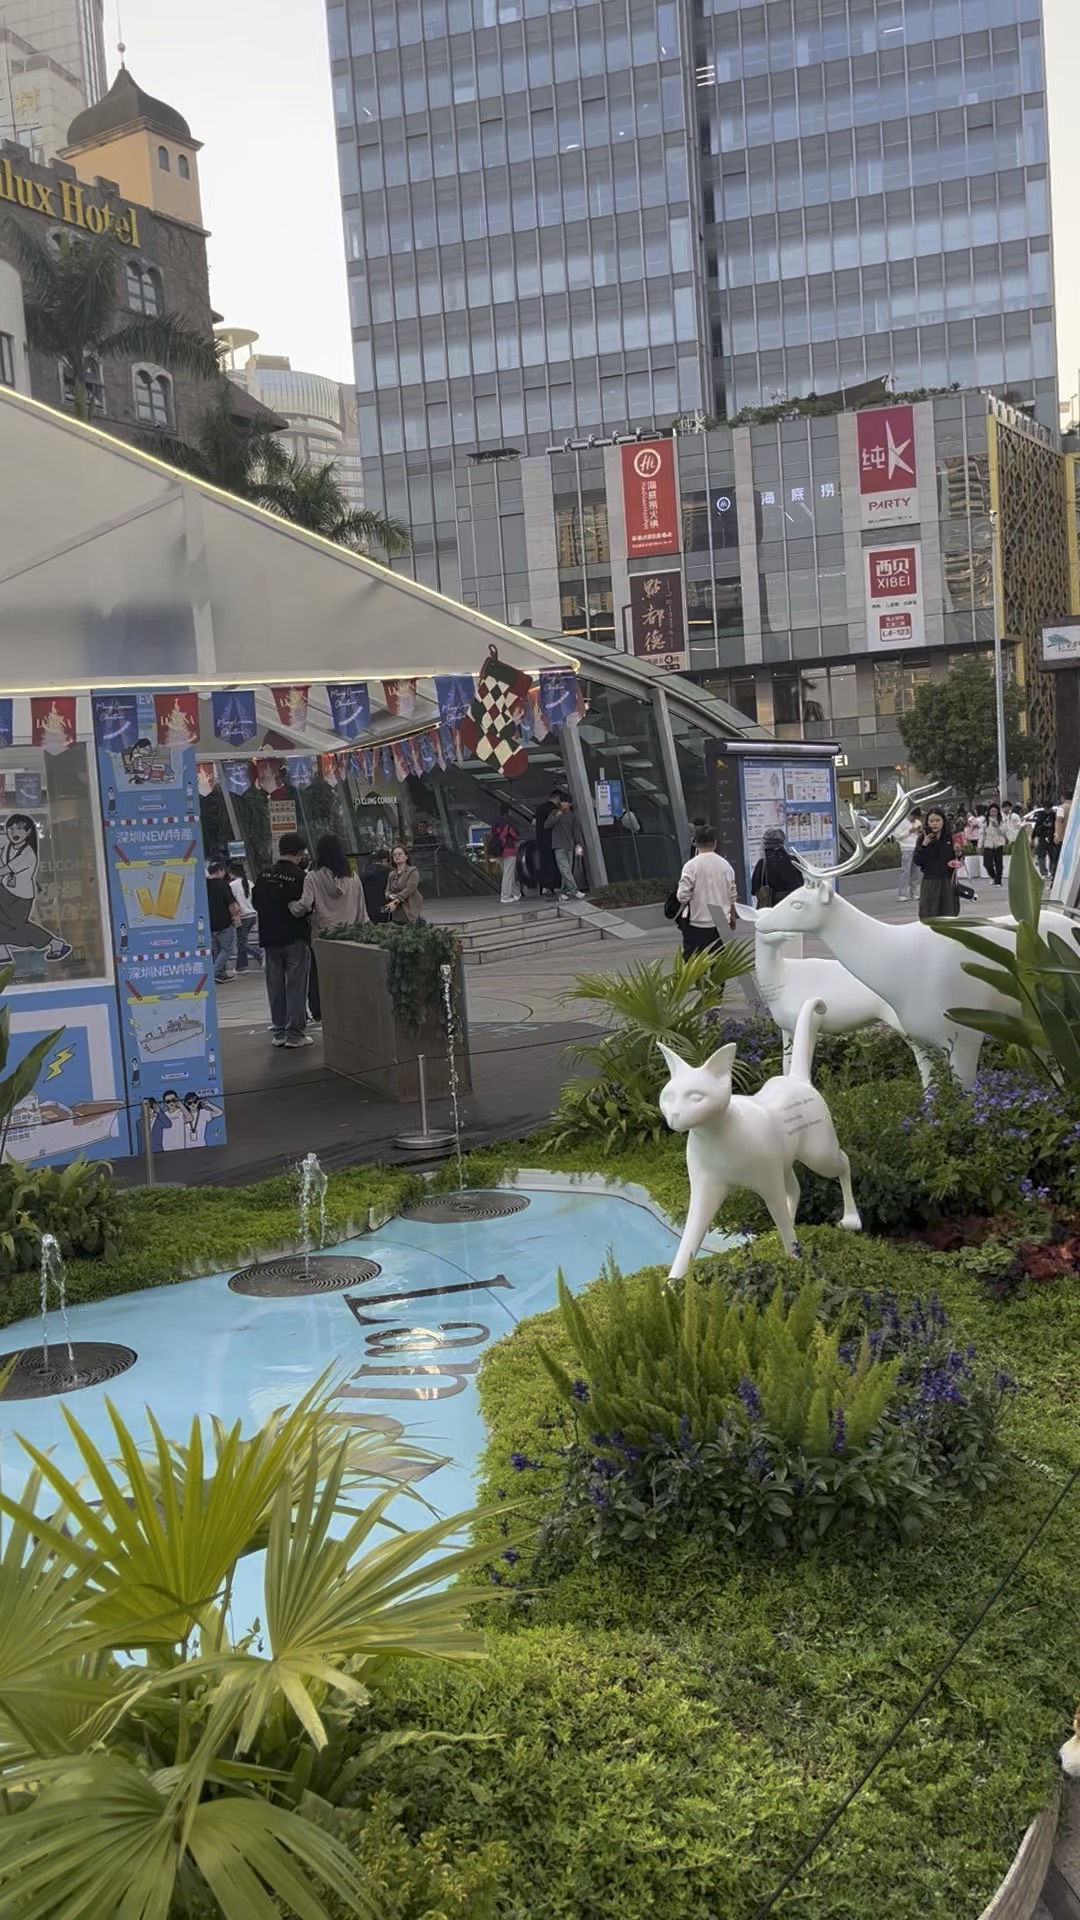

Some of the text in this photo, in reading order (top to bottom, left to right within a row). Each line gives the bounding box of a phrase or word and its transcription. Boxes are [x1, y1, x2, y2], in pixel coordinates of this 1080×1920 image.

[59, 180, 141, 249] Hotel
[868, 497, 911, 512] PARTY
[875, 558, 910, 577] 西贝
[877, 576, 911, 589] XIBEI
